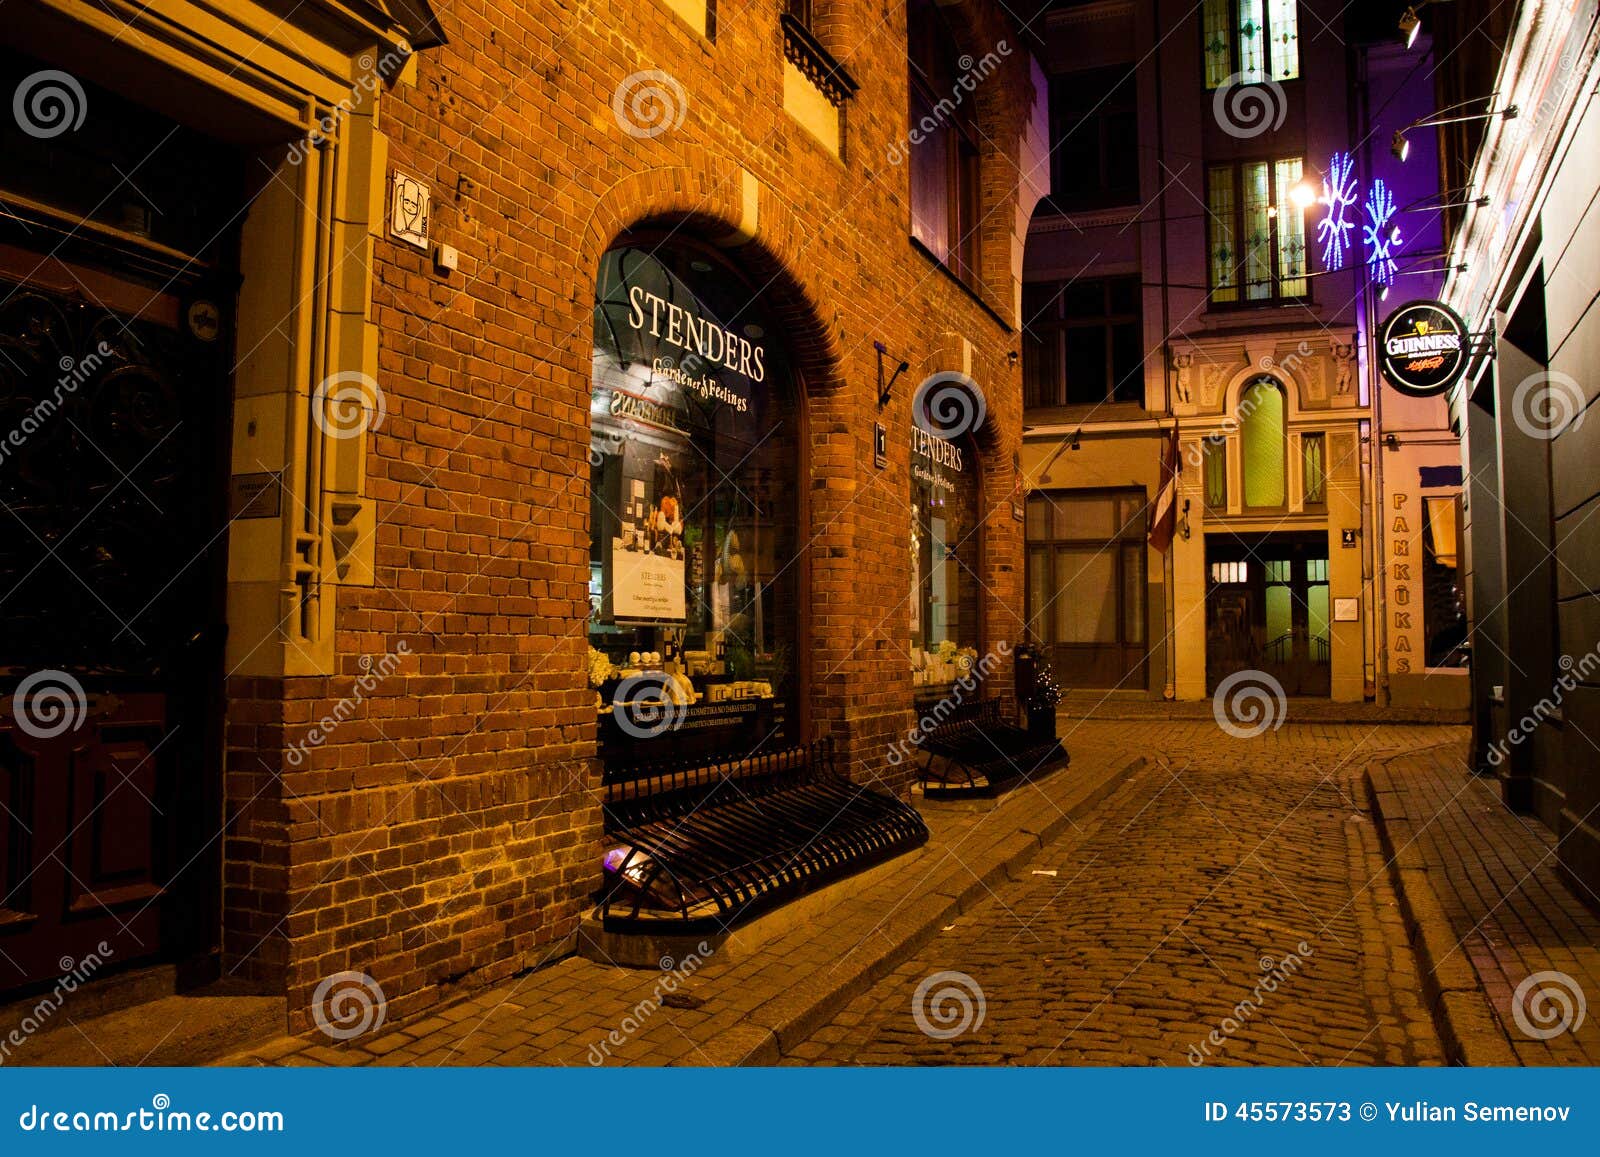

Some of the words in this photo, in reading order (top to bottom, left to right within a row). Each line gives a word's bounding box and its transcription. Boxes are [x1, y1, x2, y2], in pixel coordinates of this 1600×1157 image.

[628, 286, 765, 383] STENDERS
[1386, 335, 1461, 356] GUINNESS
[652, 358, 701, 391] Gardener
[708, 378, 747, 412] Feelings
[880, 434, 886, 452] 1
[909, 425, 963, 473] TENDERS
[1345, 533, 1352, 542] 4
[1391, 493, 1412, 675] PANKŪKAS
